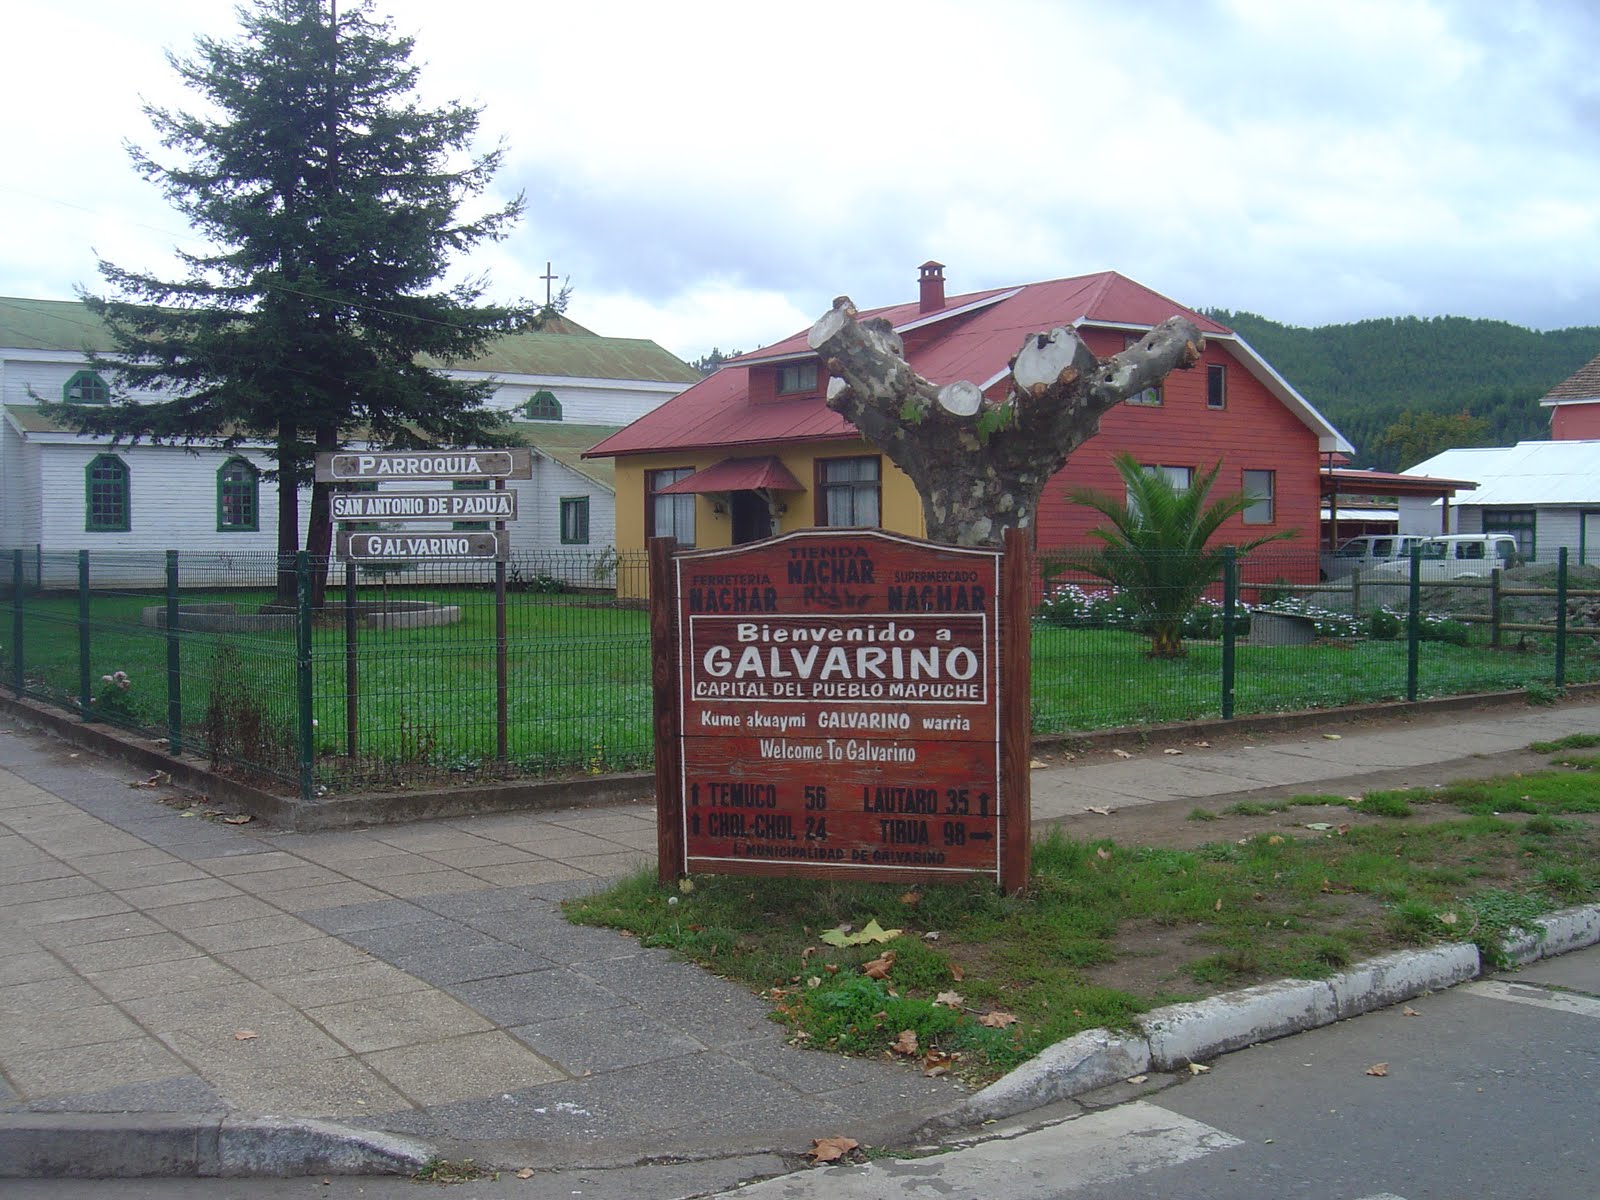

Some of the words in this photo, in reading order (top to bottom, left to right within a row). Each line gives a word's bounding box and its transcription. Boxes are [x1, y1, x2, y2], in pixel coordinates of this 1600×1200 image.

[359, 456, 482, 474] PARROQUIA
[335, 498, 364, 515] SAN
[366, 498, 424, 515] ANTONIO
[428, 498, 448, 514] DE
[452, 497, 510, 514] PADUA
[368, 536, 469, 555] GALVARINO
[787, 547, 869, 559] TIENDA
[693, 574, 771, 586] FERRETERIA
[895, 571, 978, 583] SUPERMERCADO
[737, 623, 915, 642] Bienvenido
[936, 628, 951, 641] a
[703, 645, 979, 680] GALVARINO
[696, 681, 768, 697] CAPITAL
[773, 682, 805, 697] DEL
[812, 682, 883, 698] PUEBLO
[889, 683, 979, 698] MAPUCHE
[701, 711, 741, 727] Kume
[746, 712, 806, 732] akuaymi
[818, 711, 910, 729] GALVARINO
[922, 715, 970, 731] warria
[760, 739, 823, 760] Welcome
[826, 739, 843, 760] To
[846, 740, 916, 762] Galvarino
[707, 782, 777, 809] TEMUCO
[804, 786, 826, 810] 56
[863, 787, 938, 814] LAUTARO
[946, 788, 969, 815] 35
[708, 813, 797, 840] CHOL-CHOL
[805, 816, 827, 840] 24
[880, 819, 929, 845] TIRUA
[943, 821, 966, 846] 98
[746, 845, 844, 860] MUNICIPALIDAD
[851, 849, 868, 862] DE
[872, 849, 945, 865] GALVARINO
